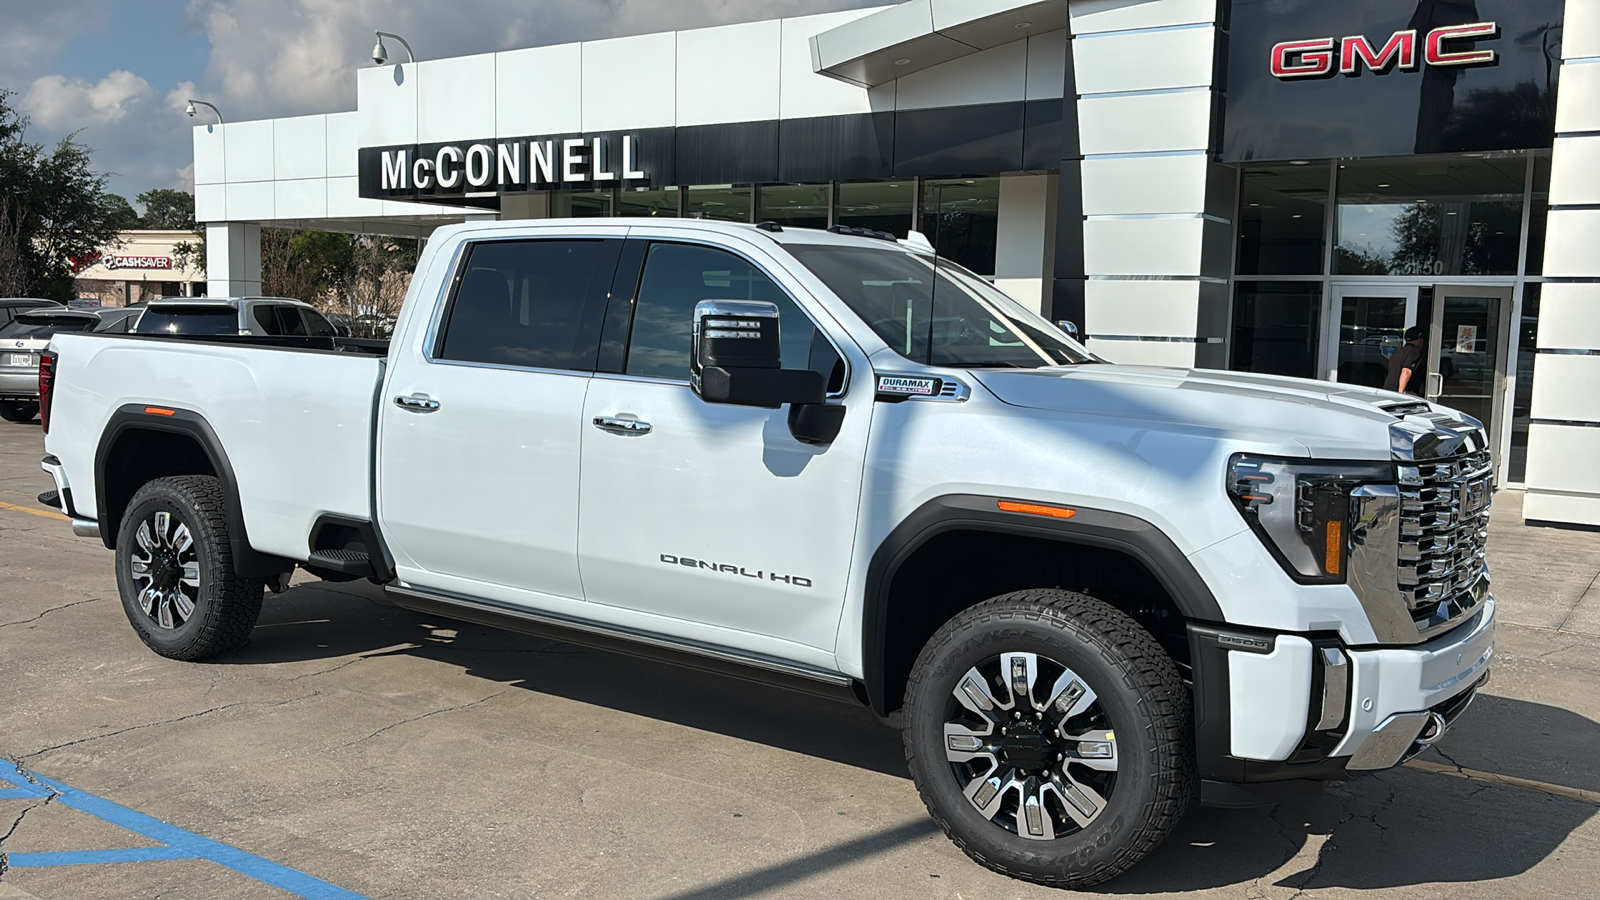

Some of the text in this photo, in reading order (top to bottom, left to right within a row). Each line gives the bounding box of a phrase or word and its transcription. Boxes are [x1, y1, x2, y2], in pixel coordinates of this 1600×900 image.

[1270, 21, 1496, 78] GMC
[882, 378, 930, 388] DURAMAX
[660, 553, 812, 587] DENALI HD
